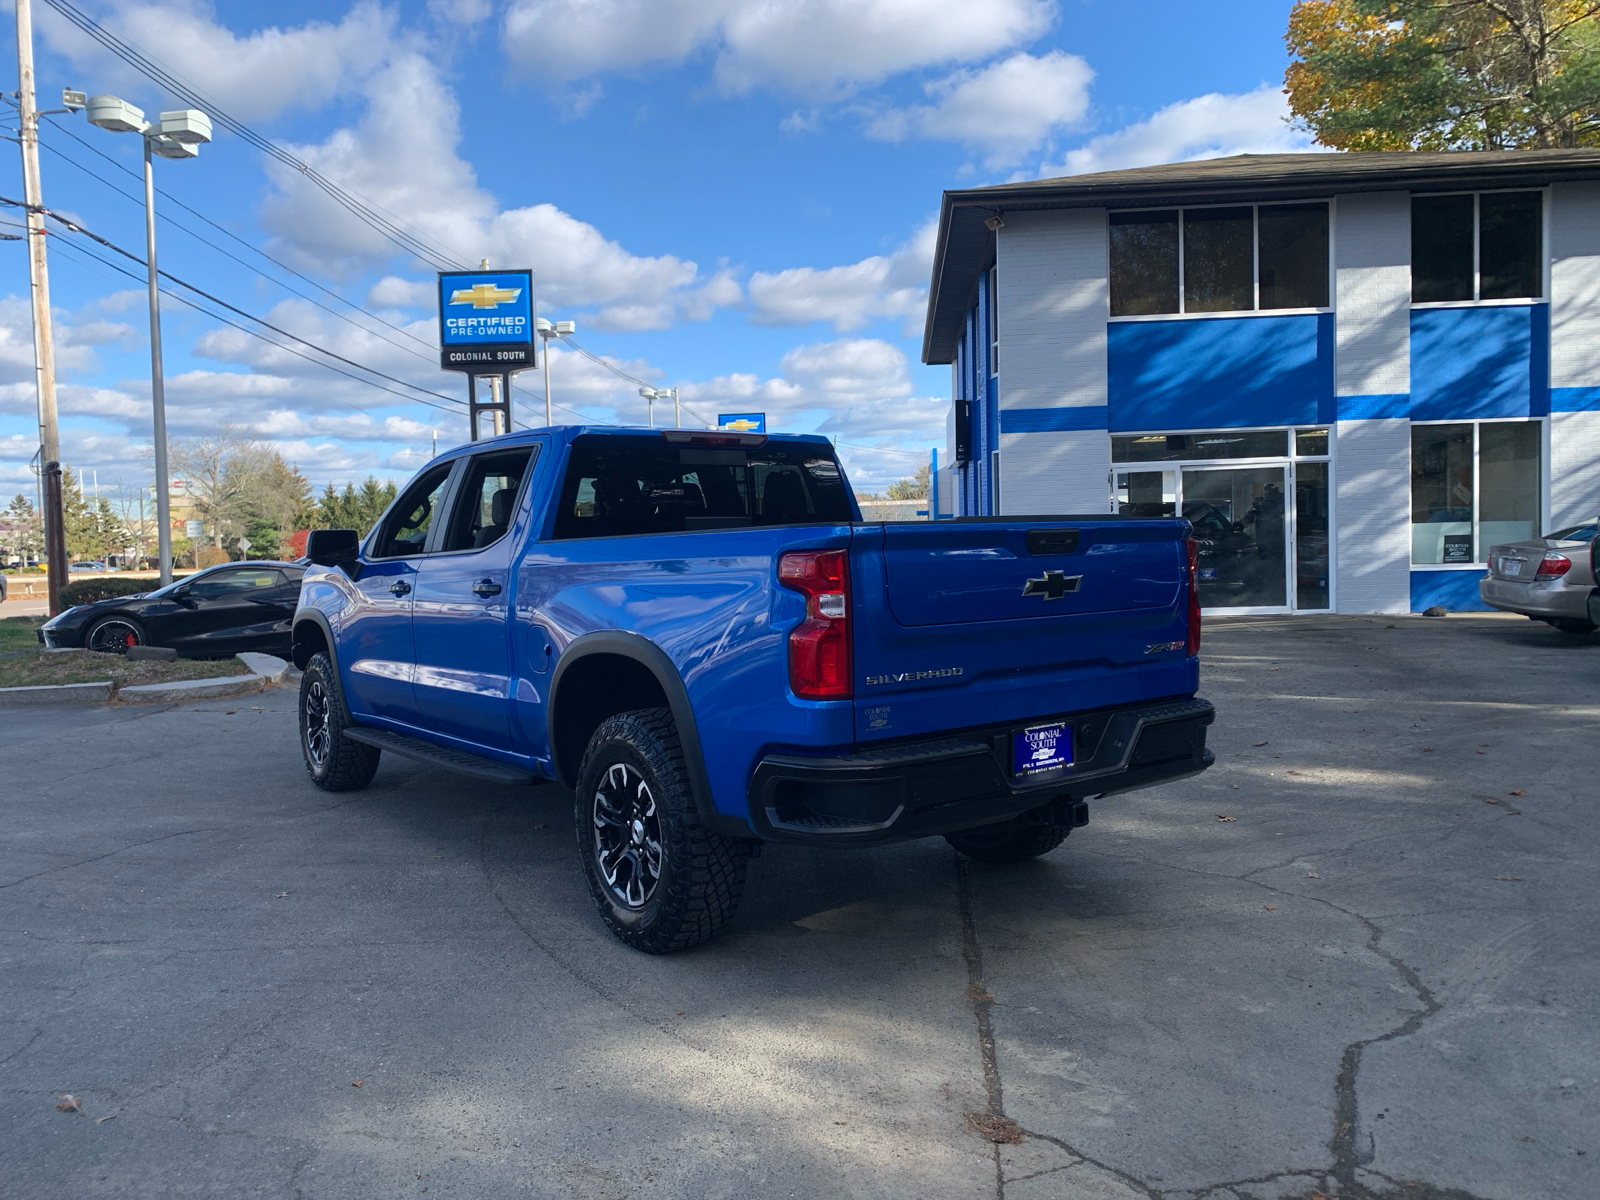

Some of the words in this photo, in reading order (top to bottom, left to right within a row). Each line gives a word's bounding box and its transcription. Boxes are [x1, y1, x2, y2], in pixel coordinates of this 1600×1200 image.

[446, 316, 526, 327] CERTIFIED
[450, 326, 522, 336] PRE-OWNED
[449, 352, 493, 361] COLONIAL
[496, 351, 525, 360] SOUTH
[866, 667, 964, 686] SILVERADO
[1024, 729, 1062, 742] COLONIAL
[1030, 738, 1056, 750] SOUTH
